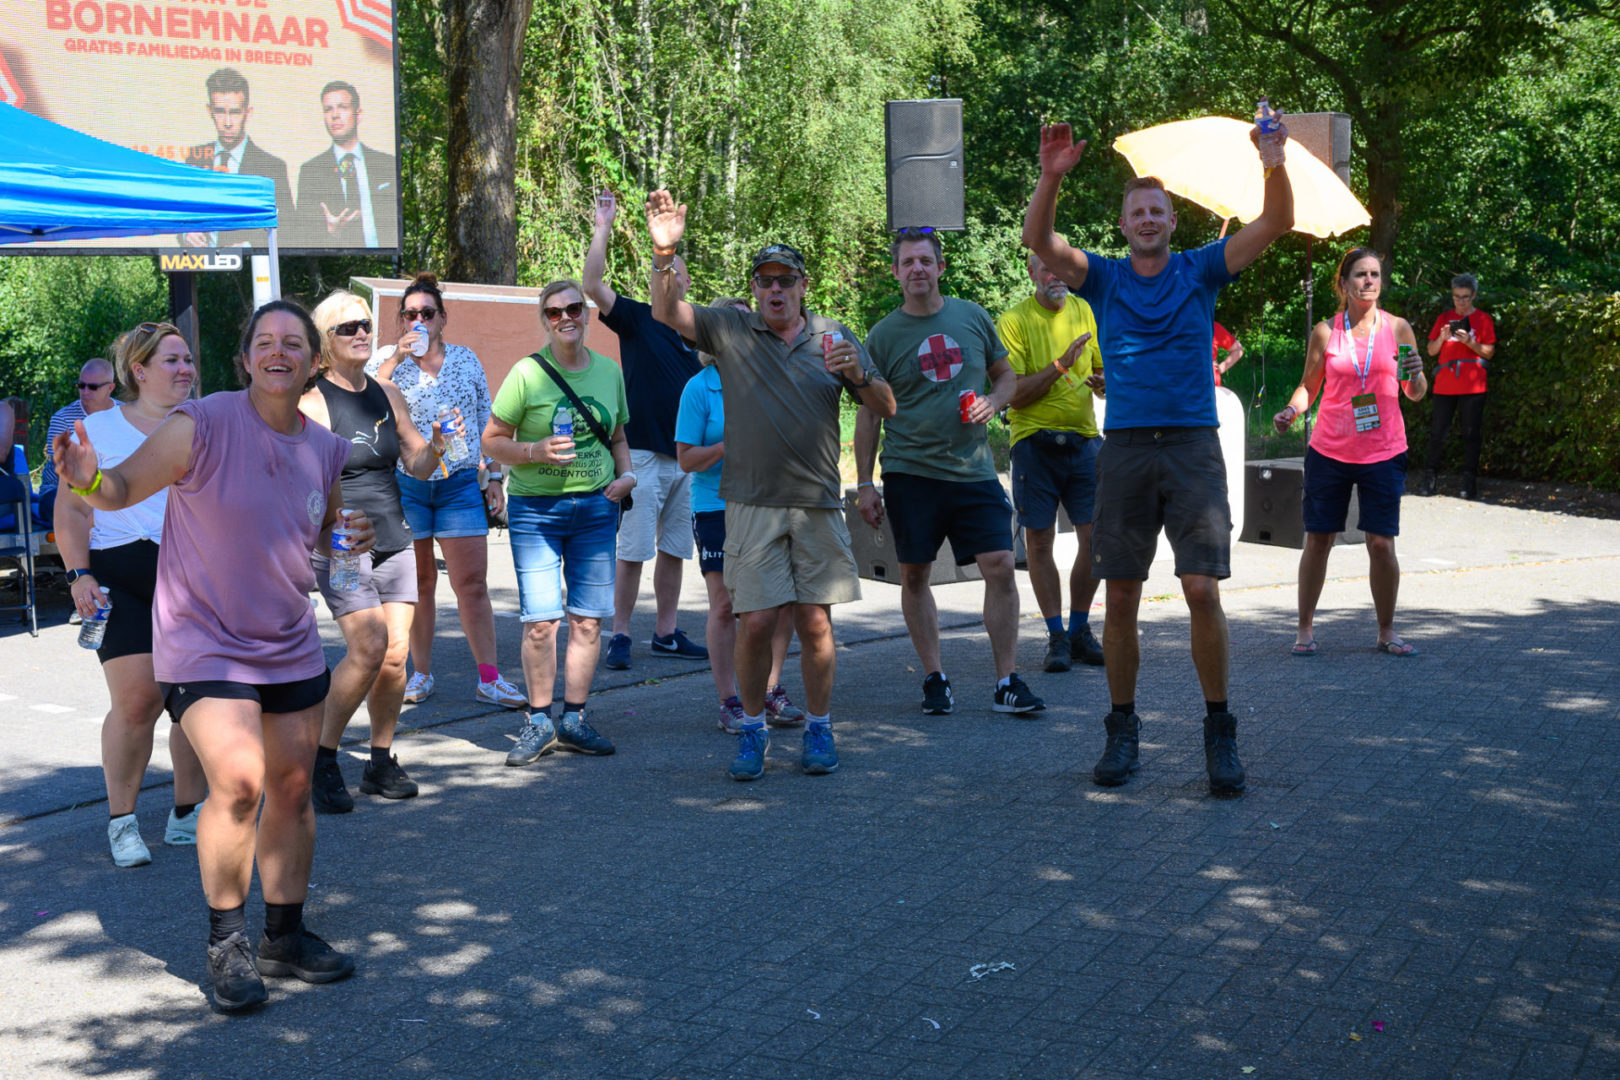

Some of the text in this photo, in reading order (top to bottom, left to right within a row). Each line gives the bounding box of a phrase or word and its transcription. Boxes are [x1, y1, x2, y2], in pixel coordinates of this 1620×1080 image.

[46, 0, 329, 48] BORNEMNAAR
[64, 38, 313, 66] GRATIS FAMILIEDAG IN BREEVEN
[180, 146, 214, 160] UUR
[161, 254, 241, 270] MAXLED
[538, 467, 603, 478] DODENTOCHT
